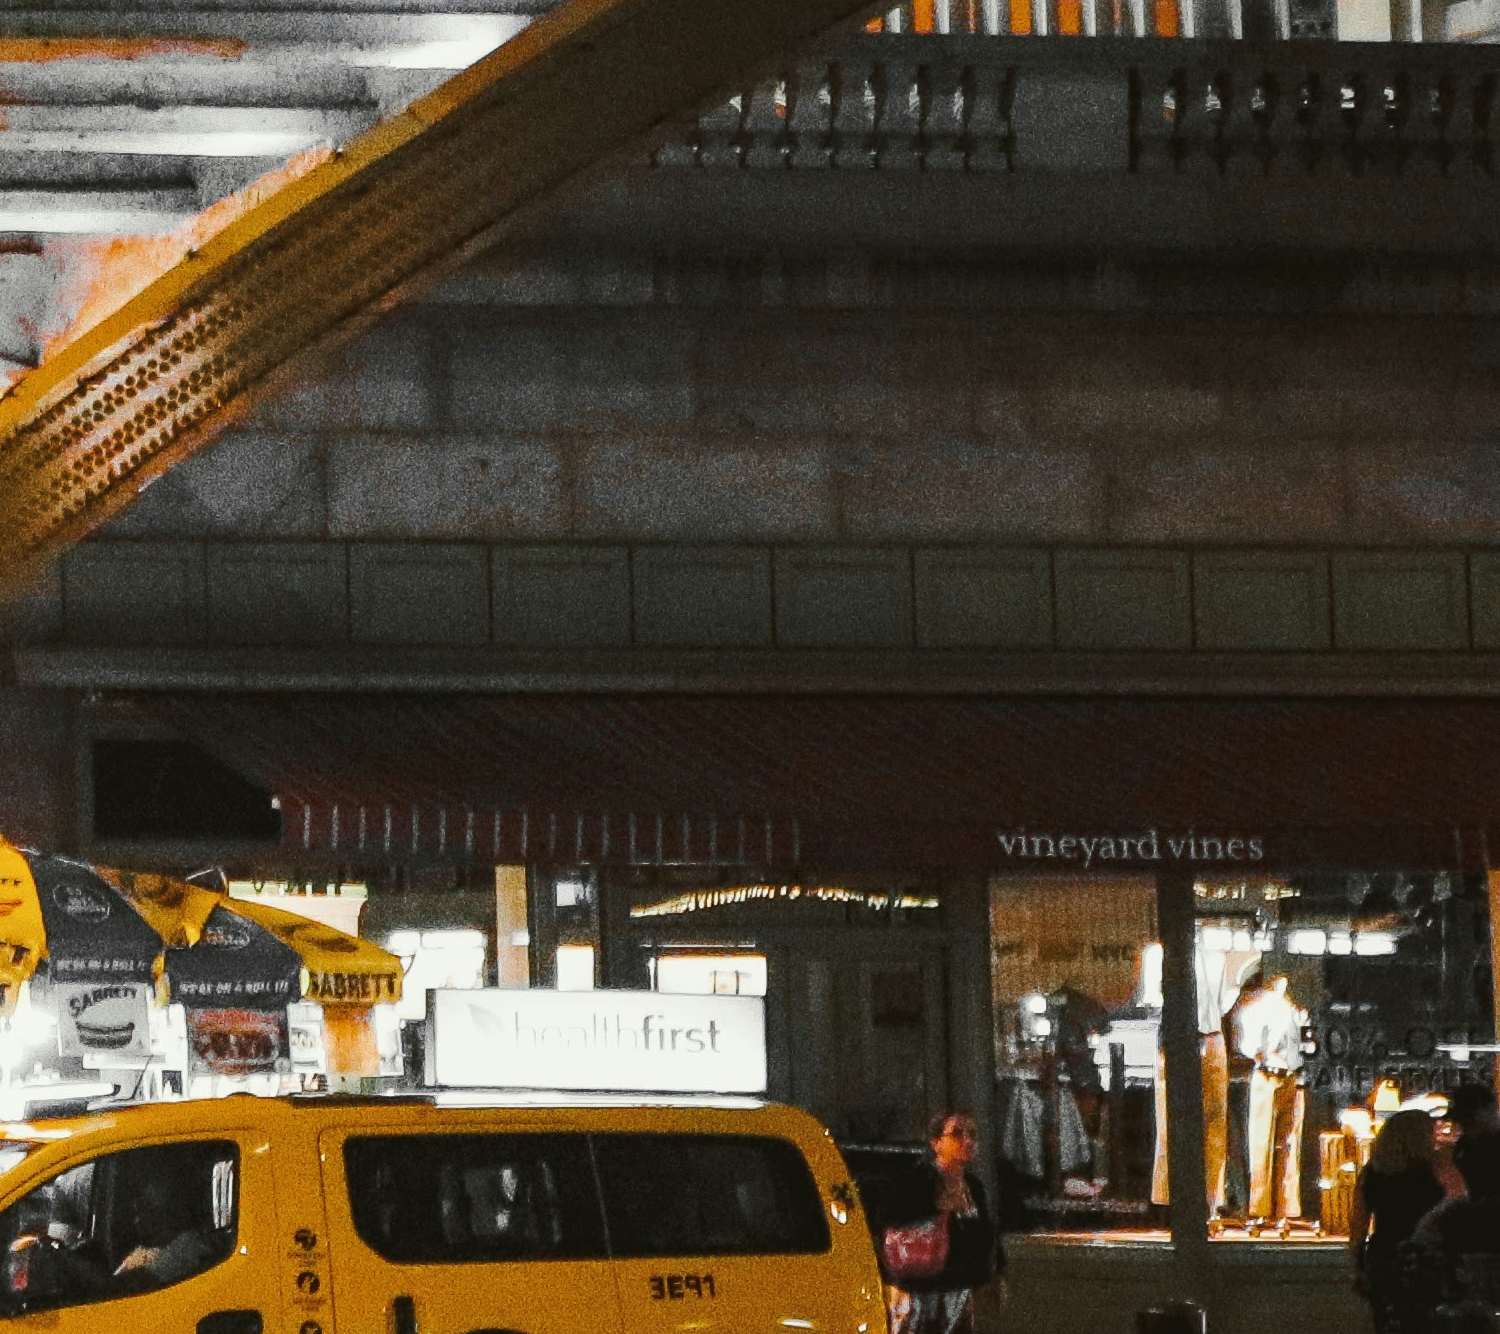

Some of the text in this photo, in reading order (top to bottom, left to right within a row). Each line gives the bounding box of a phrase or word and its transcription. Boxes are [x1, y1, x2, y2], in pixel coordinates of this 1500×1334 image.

[997, 828, 1263, 869] vineyard vines
[515, 1010, 722, 1054] healthfirst
[650, 1273, 717, 1301] 3E91
